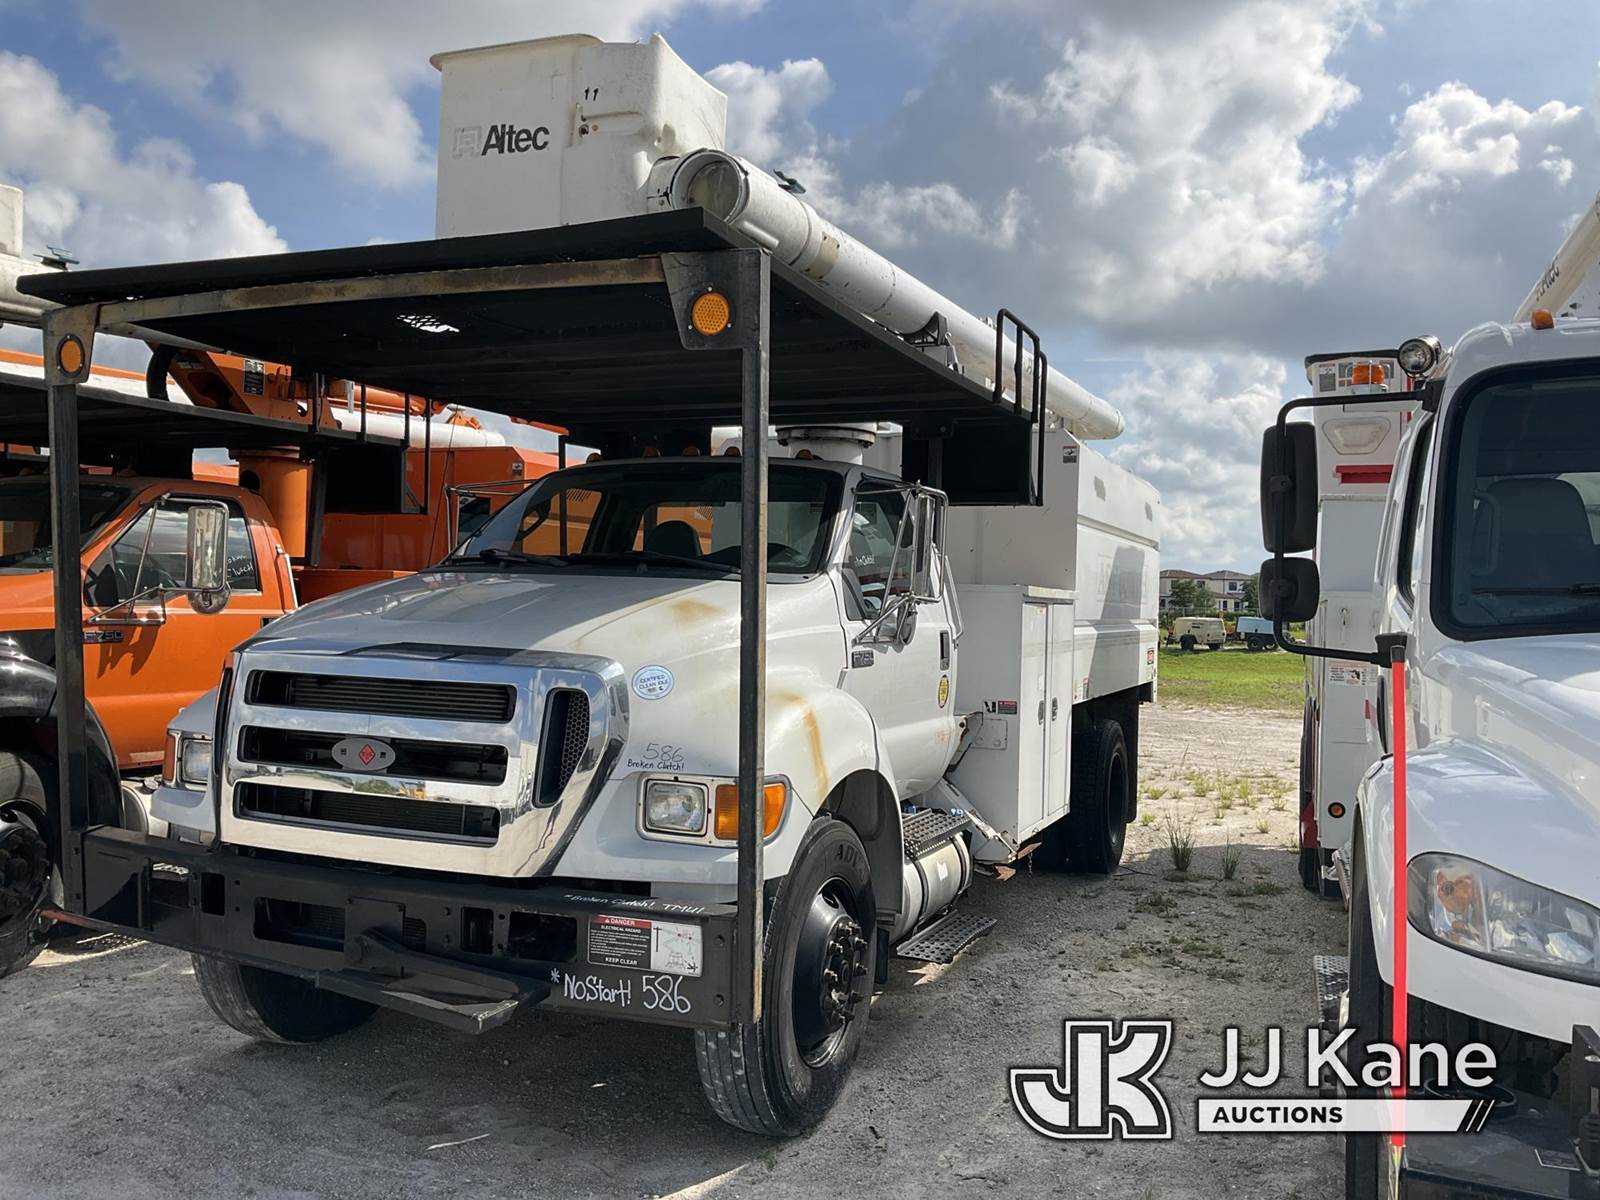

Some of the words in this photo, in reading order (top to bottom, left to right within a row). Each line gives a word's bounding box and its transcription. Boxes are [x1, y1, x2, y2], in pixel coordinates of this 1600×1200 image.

[584, 87, 599, 101] 11
[481, 123, 550, 156] Altec
[643, 742, 684, 763] 586
[627, 758, 655, 769] Broken
[610, 918, 637, 927] DANGER
[605, 956, 620, 965] KEEP
[620, 958, 638, 966] CLEAR
[642, 974, 692, 1014] 586
